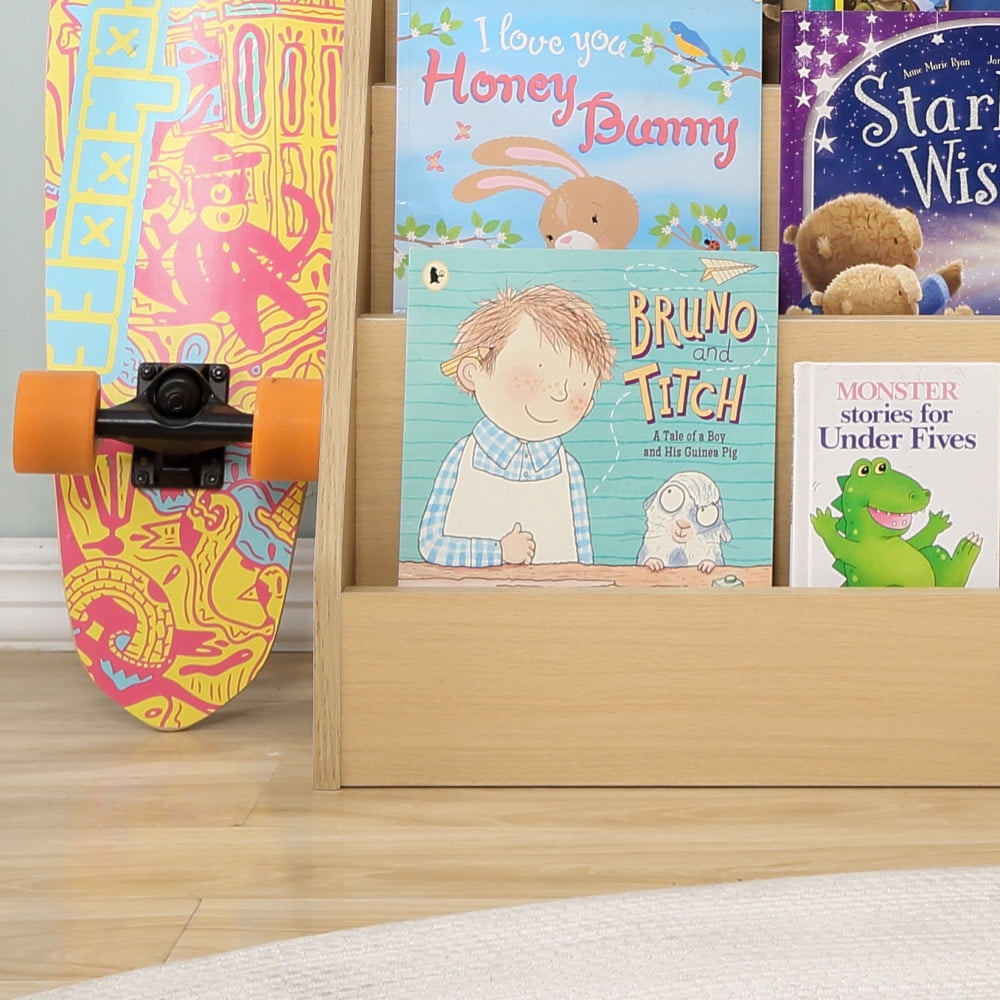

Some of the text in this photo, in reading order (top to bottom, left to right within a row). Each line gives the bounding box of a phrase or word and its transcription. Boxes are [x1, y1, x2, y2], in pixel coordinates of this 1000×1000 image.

[474, 12, 629, 68] I love you
[903, 68, 923, 80] Anne
[924, 60, 948, 73] Marie
[950, 57, 971, 70] Ryan
[422, 48, 578, 128] Honey
[576, 91, 740, 171] Bunny
[628, 290, 758, 360] BRUNO
[693, 338, 735, 364] and
[624, 363, 747, 425] TITCH
[836, 381, 960, 401] MONSTER
[840, 403, 954, 424] stories for
[653, 429, 726, 445] A Tale of a Boy
[818, 425, 977, 450] Under Fives
[643, 446, 738, 461] and His Guinea Pig
